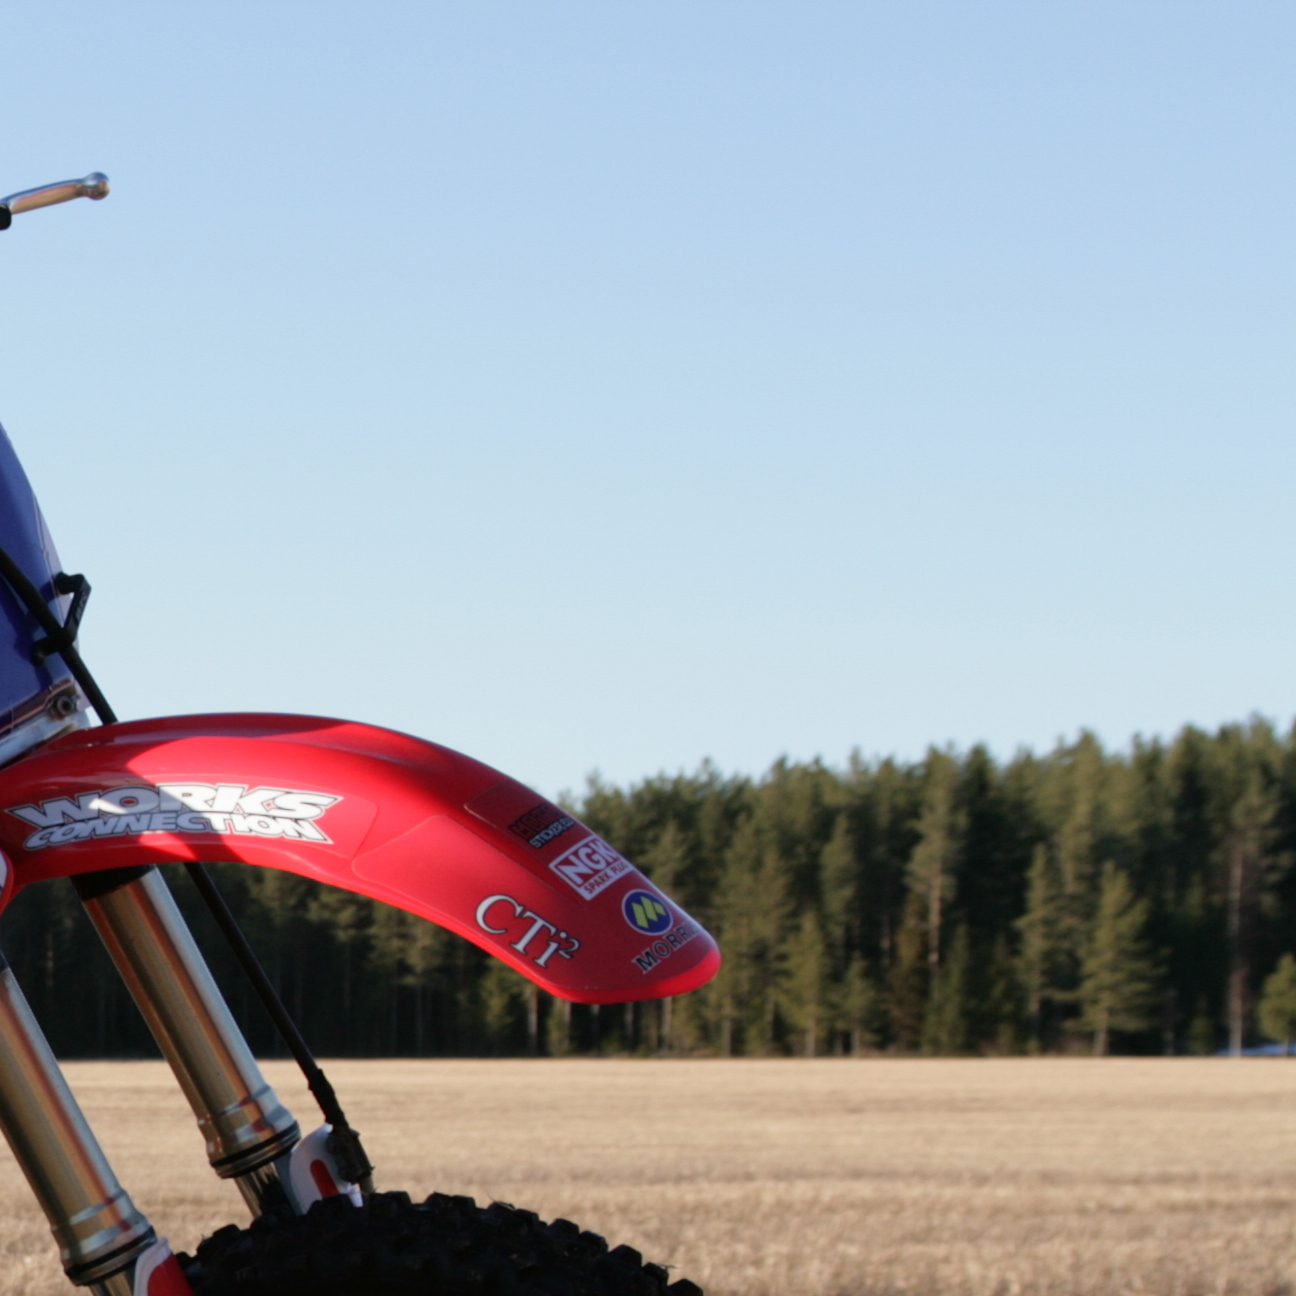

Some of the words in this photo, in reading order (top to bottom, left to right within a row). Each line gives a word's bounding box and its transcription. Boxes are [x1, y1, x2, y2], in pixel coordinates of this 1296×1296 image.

[9, 782, 344, 828] WORKS
[24, 810, 332, 849] CONNECTION
[557, 839, 622, 886] NGK
